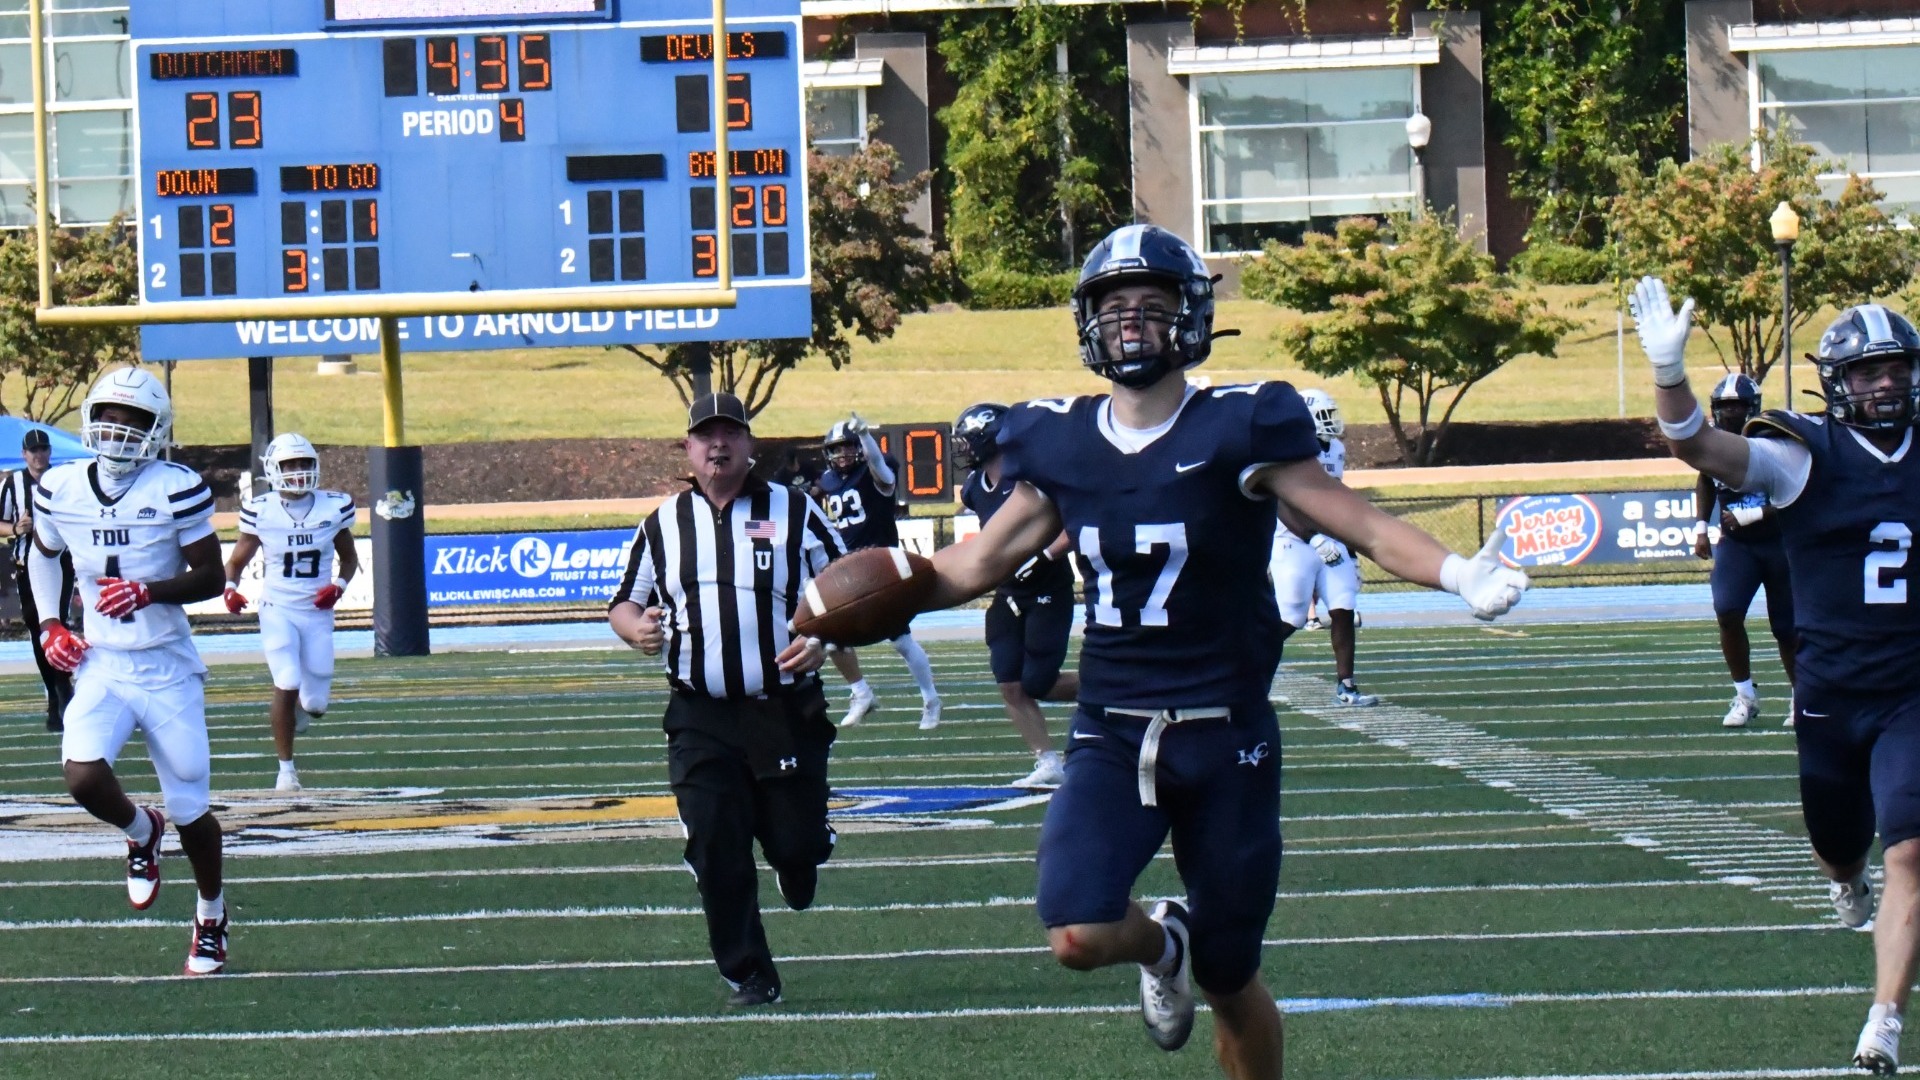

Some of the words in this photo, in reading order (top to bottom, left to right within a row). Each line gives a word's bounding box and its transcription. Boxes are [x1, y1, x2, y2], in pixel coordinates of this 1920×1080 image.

[667, 32, 755, 60] DEVLS
[158, 49, 283, 77] DUTCHMEN
[428, 35, 549, 89] 4:35
[437, 93, 499, 102] DAKTRONICS
[188, 93, 260, 146] 23
[402, 108, 494, 137] PERIOD
[500, 101, 523, 135] 4
[689, 151, 747, 176] BAL
[754, 149, 783, 174] ON
[157, 169, 218, 196] DOWN
[306, 165, 337, 190] TO
[348, 163, 377, 189] GO
[559, 200, 572, 225] 1
[731, 184, 787, 227] 20
[149, 214, 163, 239] 1
[211, 204, 233, 245] 2
[560, 248, 576, 273] 2
[696, 235, 717, 276] 3
[151, 263, 167, 288] 2
[473, 311, 615, 337] ARNOLD
[625, 308, 720, 331] FIELD
[828, 488, 867, 530] 23
[1506, 506, 1585, 536] Jersey
[1622, 500, 1644, 520] a
[92, 529, 130, 546] FDU
[287, 534, 314, 546] FDU
[432, 546, 509, 575] Klick
[551, 541, 632, 569] Lewi
[755, 550, 772, 571] U
[1536, 551, 1567, 566] SUBS
[1864, 521, 1913, 604] 2
[550, 570, 586, 581] TRUST
[588, 570, 599, 580] IS
[600, 569, 624, 579] EAR
[1079, 522, 1189, 628] 17
[430, 586, 566, 601] KLICKLEWISCARS.COM
